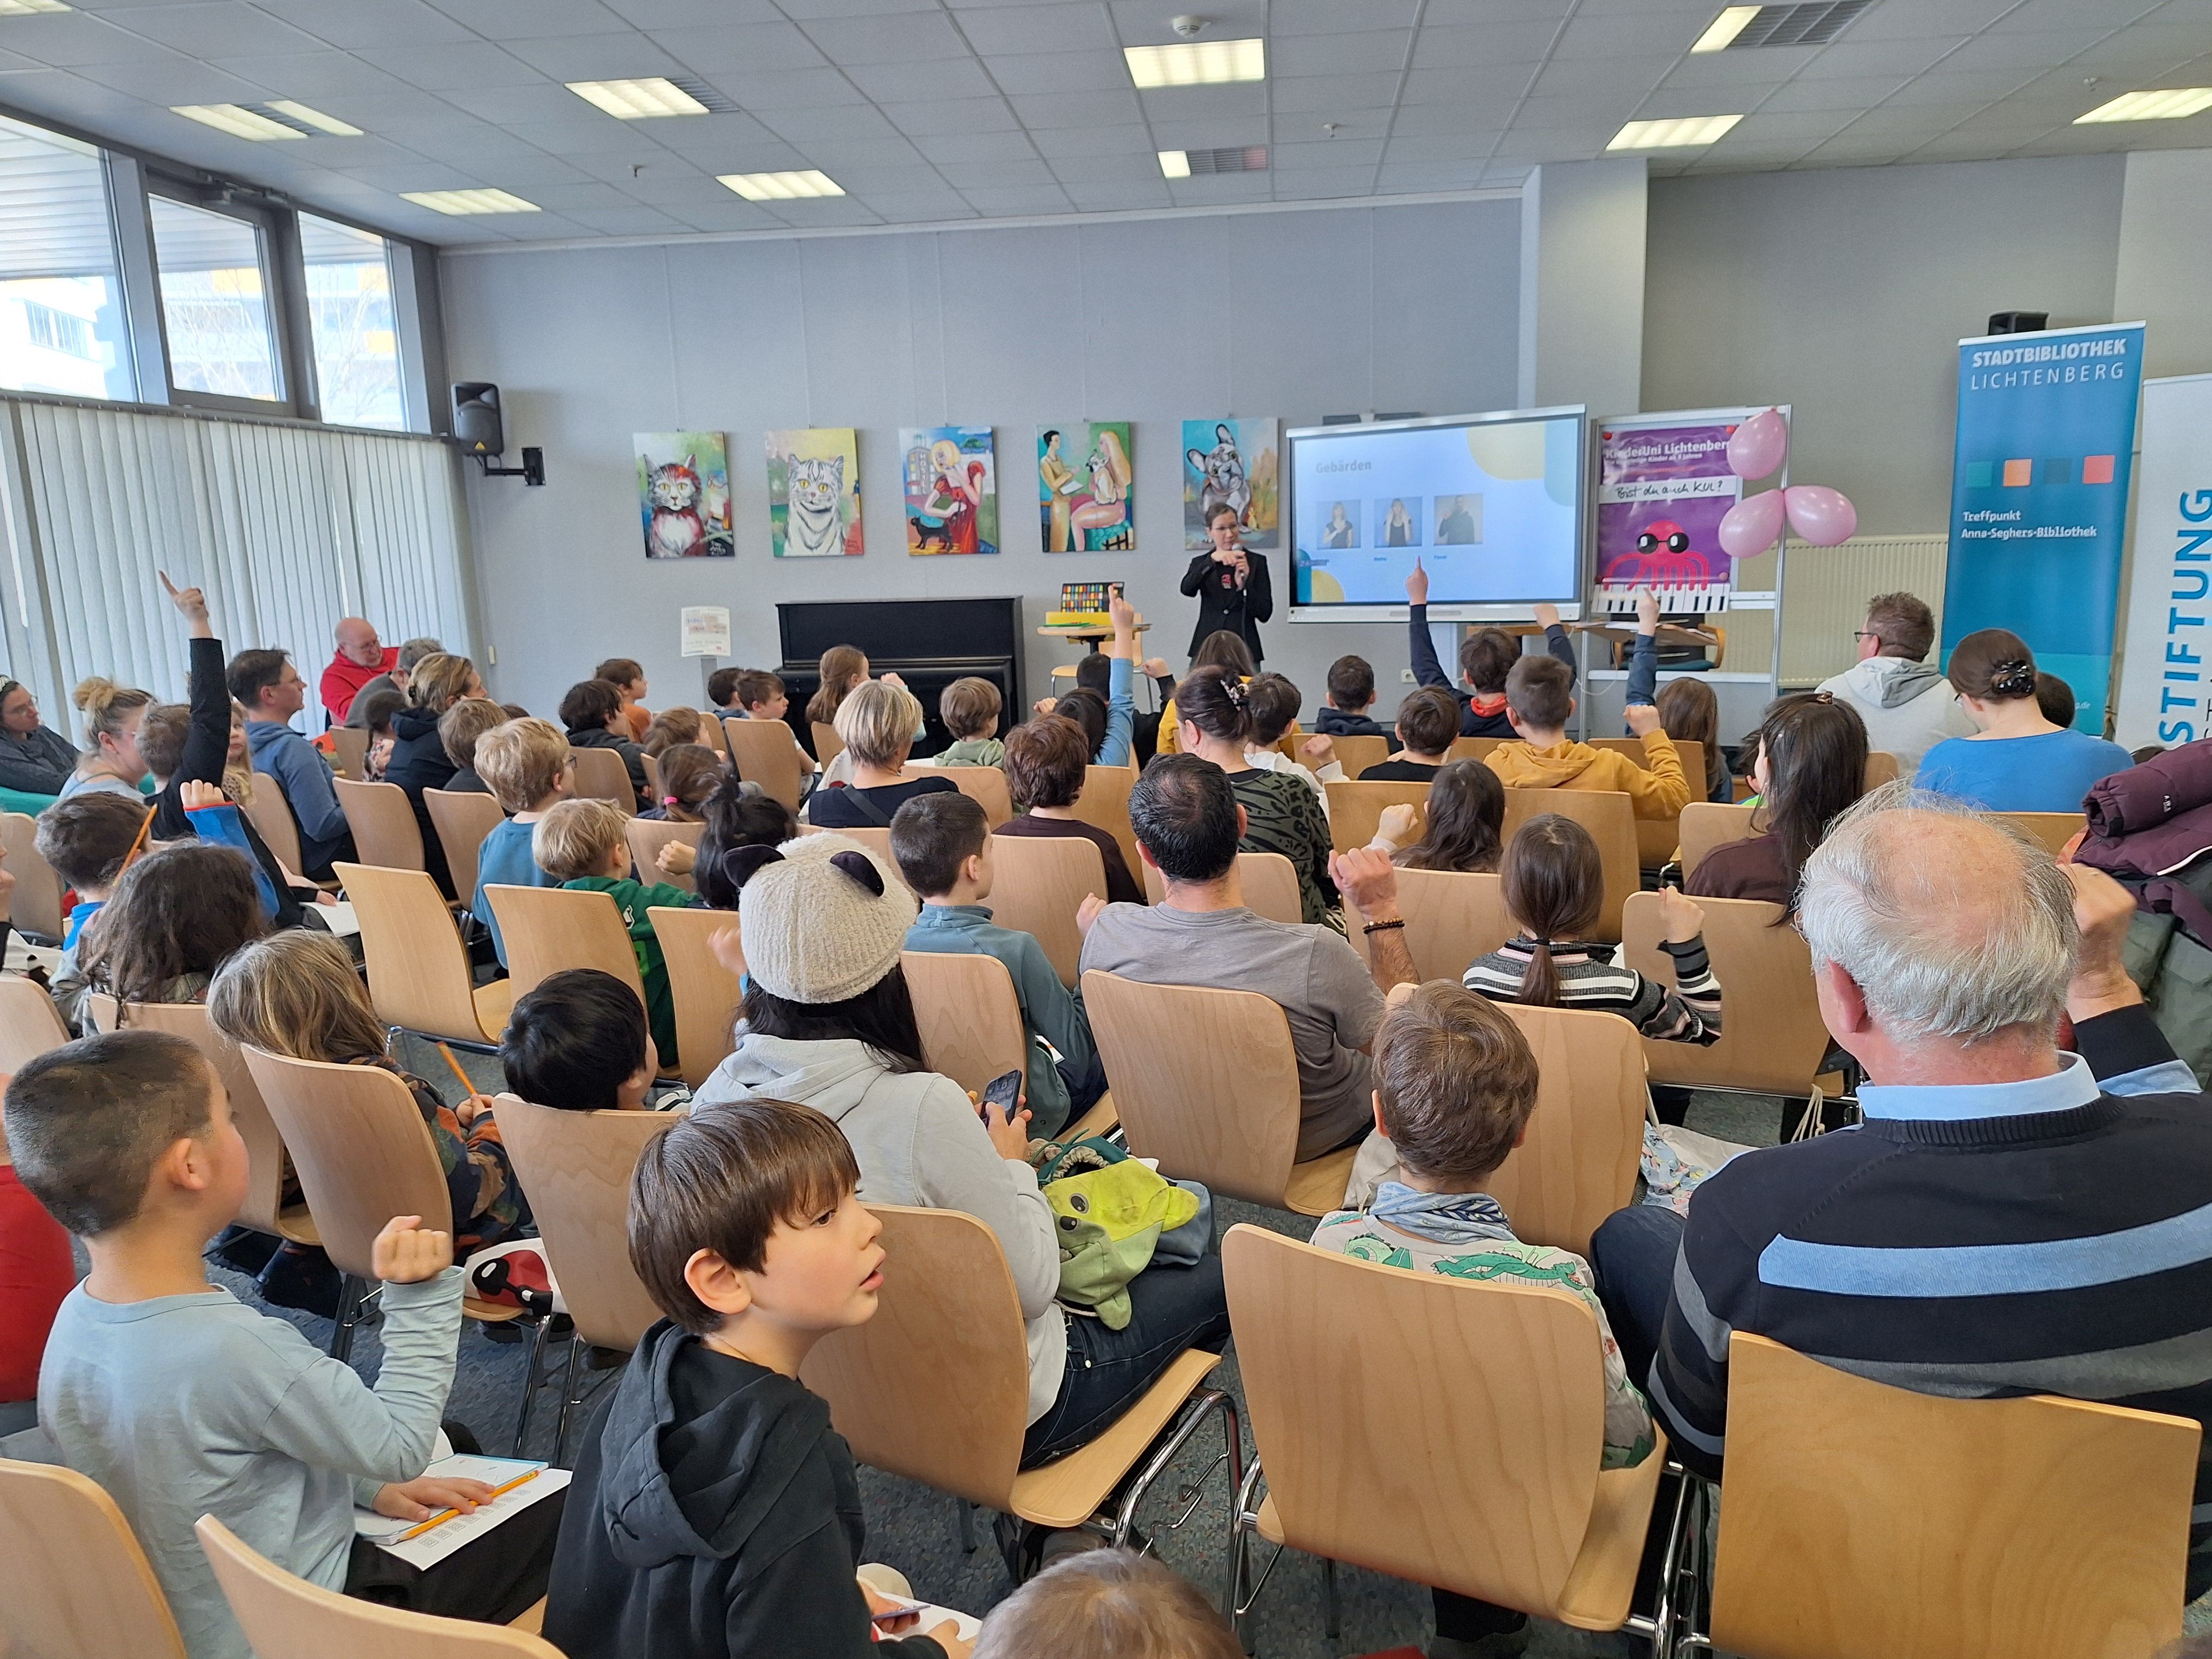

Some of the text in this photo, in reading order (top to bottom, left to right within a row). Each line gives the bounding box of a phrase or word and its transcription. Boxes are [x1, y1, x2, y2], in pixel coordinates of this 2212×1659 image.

[1972, 338, 2127, 368] STADTBIBLIOTHEK
[1971, 362, 2125, 391] LICHTENBERG
[1605, 443, 1661, 459] KiderUni
[1316, 460, 1372, 473] Gebärden
[1616, 485, 1642, 499] Bist
[1643, 485, 1659, 495] du
[1662, 483, 1688, 494] auch
[1963, 510, 2021, 523] Treffpunkt
[1961, 525, 2097, 541] Anna-Seghers-Bibliothek
[2159, 489, 2212, 743] STIFTUNG
